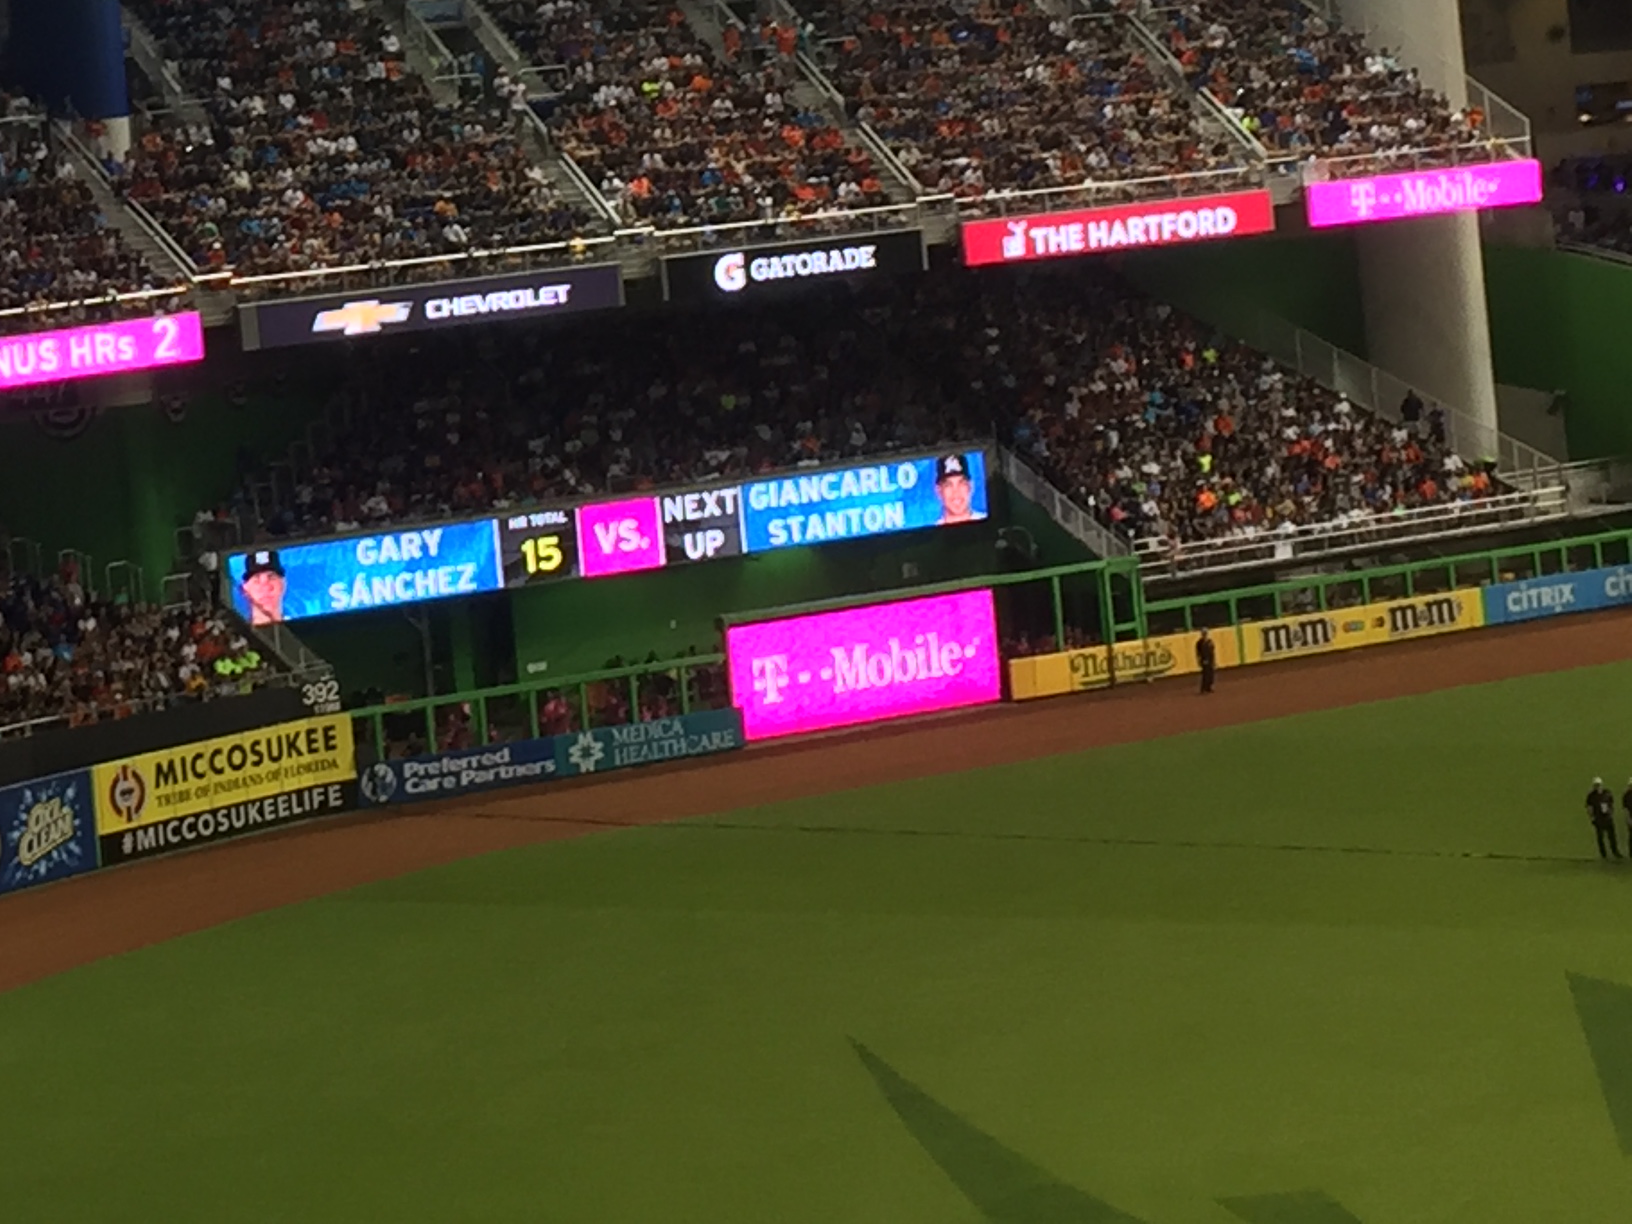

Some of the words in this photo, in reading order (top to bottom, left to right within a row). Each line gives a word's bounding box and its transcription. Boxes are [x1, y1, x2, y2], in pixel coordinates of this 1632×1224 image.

[1029, 223, 1084, 255] THE
[1088, 206, 1238, 249] HARTFORD
[750, 245, 876, 282] GATORADE
[424, 284, 572, 320] CHEVROLET
[70, 331, 134, 368] HRs
[152, 316, 179, 360] 2
[748, 461, 919, 511] GIANCARLO
[663, 487, 736, 523] NEXT
[594, 518, 651, 555] VS.
[767, 502, 906, 546] STANTON
[355, 528, 444, 565] GARY
[521, 536, 563, 574] 15
[683, 529, 725, 561] UP
[328, 562, 478, 609] SÁNCHEZ
[302, 680, 339, 705] 392
[612, 718, 685, 746] MEDICA
[614, 728, 735, 767] HEALTHCARE
[154, 724, 338, 789] MICCOSUKEE
[402, 746, 511, 777] Preferred
[156, 790, 192, 809] TRIBE
[194, 783, 210, 799] OF
[212, 774, 264, 796] INDIANS
[283, 757, 339, 780] FLORIDA
[404, 773, 457, 795] Care
[459, 758, 556, 786] Partners
[121, 784, 344, 855] #MICCOSUKEELIFE
